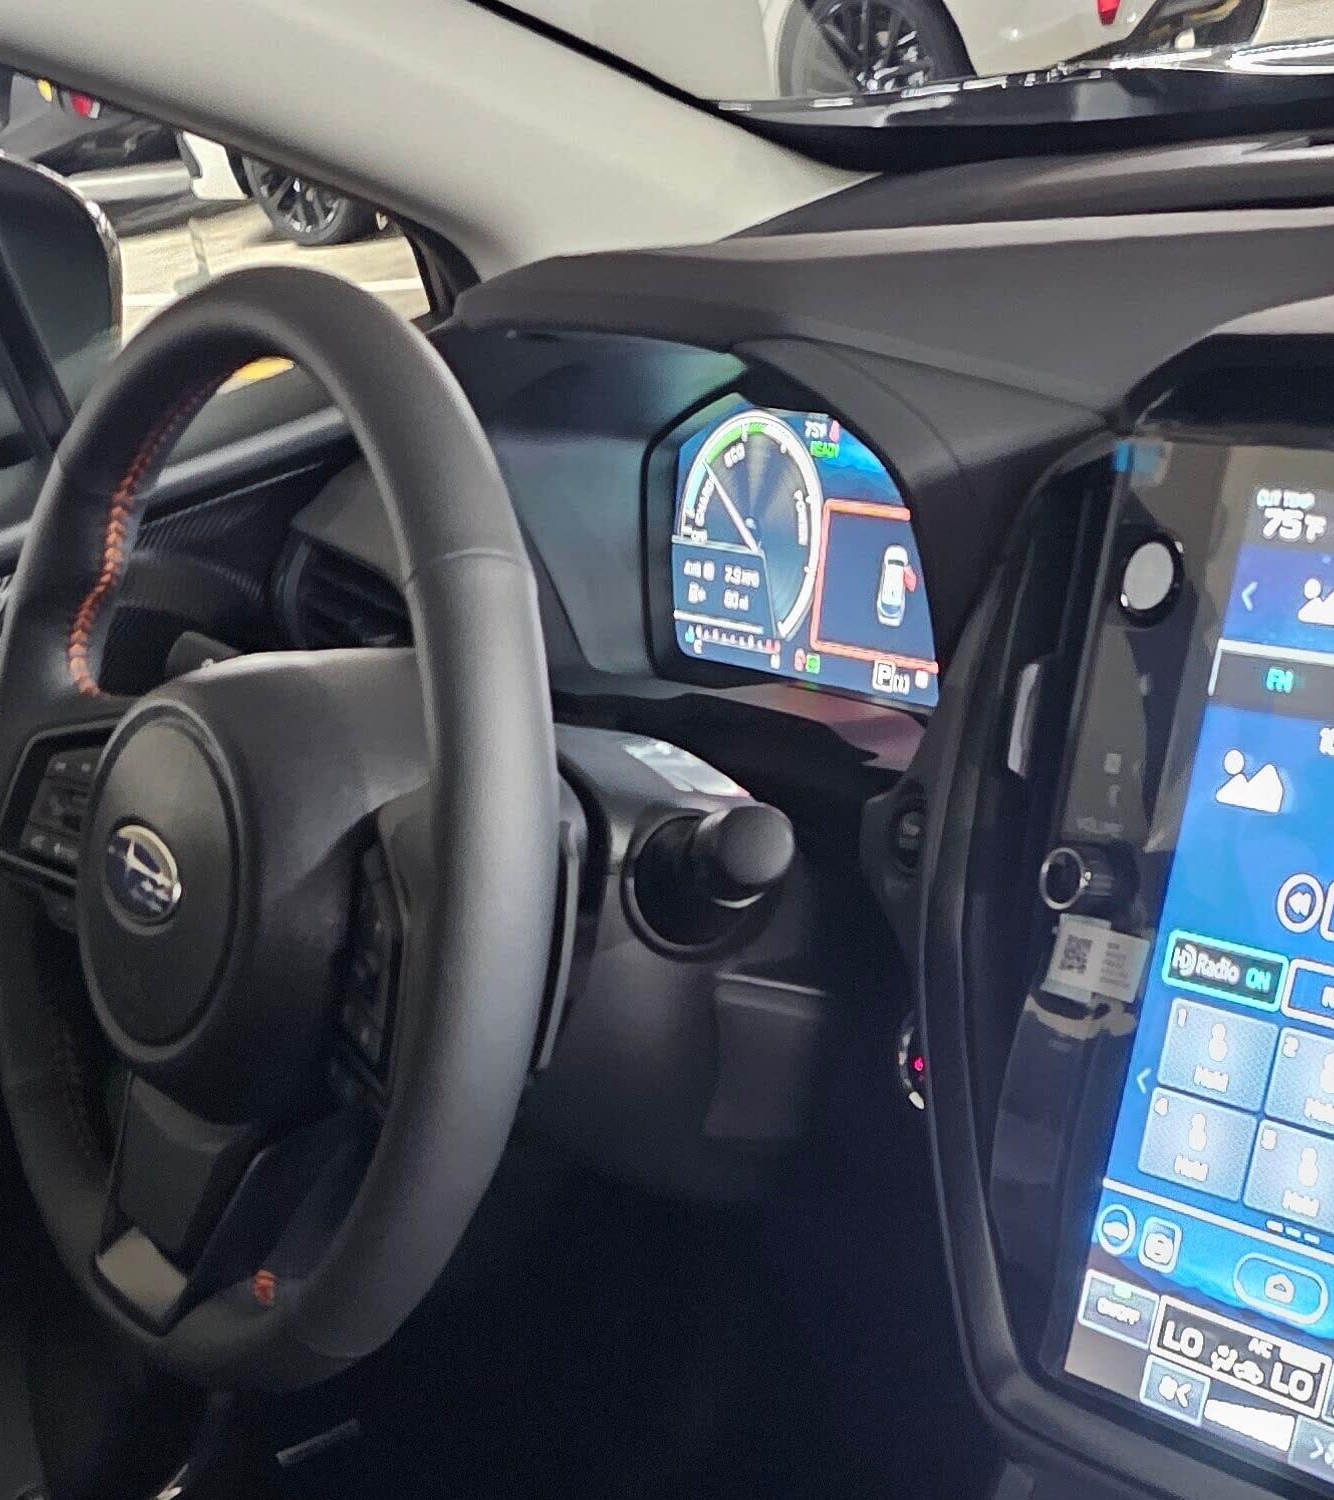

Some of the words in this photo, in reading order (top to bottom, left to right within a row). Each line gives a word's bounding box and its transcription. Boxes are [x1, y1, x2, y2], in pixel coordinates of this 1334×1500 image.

[1266, 666, 1293, 693] FM
[1195, 952, 1240, 985] Radio
[1246, 967, 1272, 992] ON
[1283, 1035, 1300, 1058] 2
[1165, 1320, 1205, 1358] LO
[1270, 1367, 1315, 1401] LO
